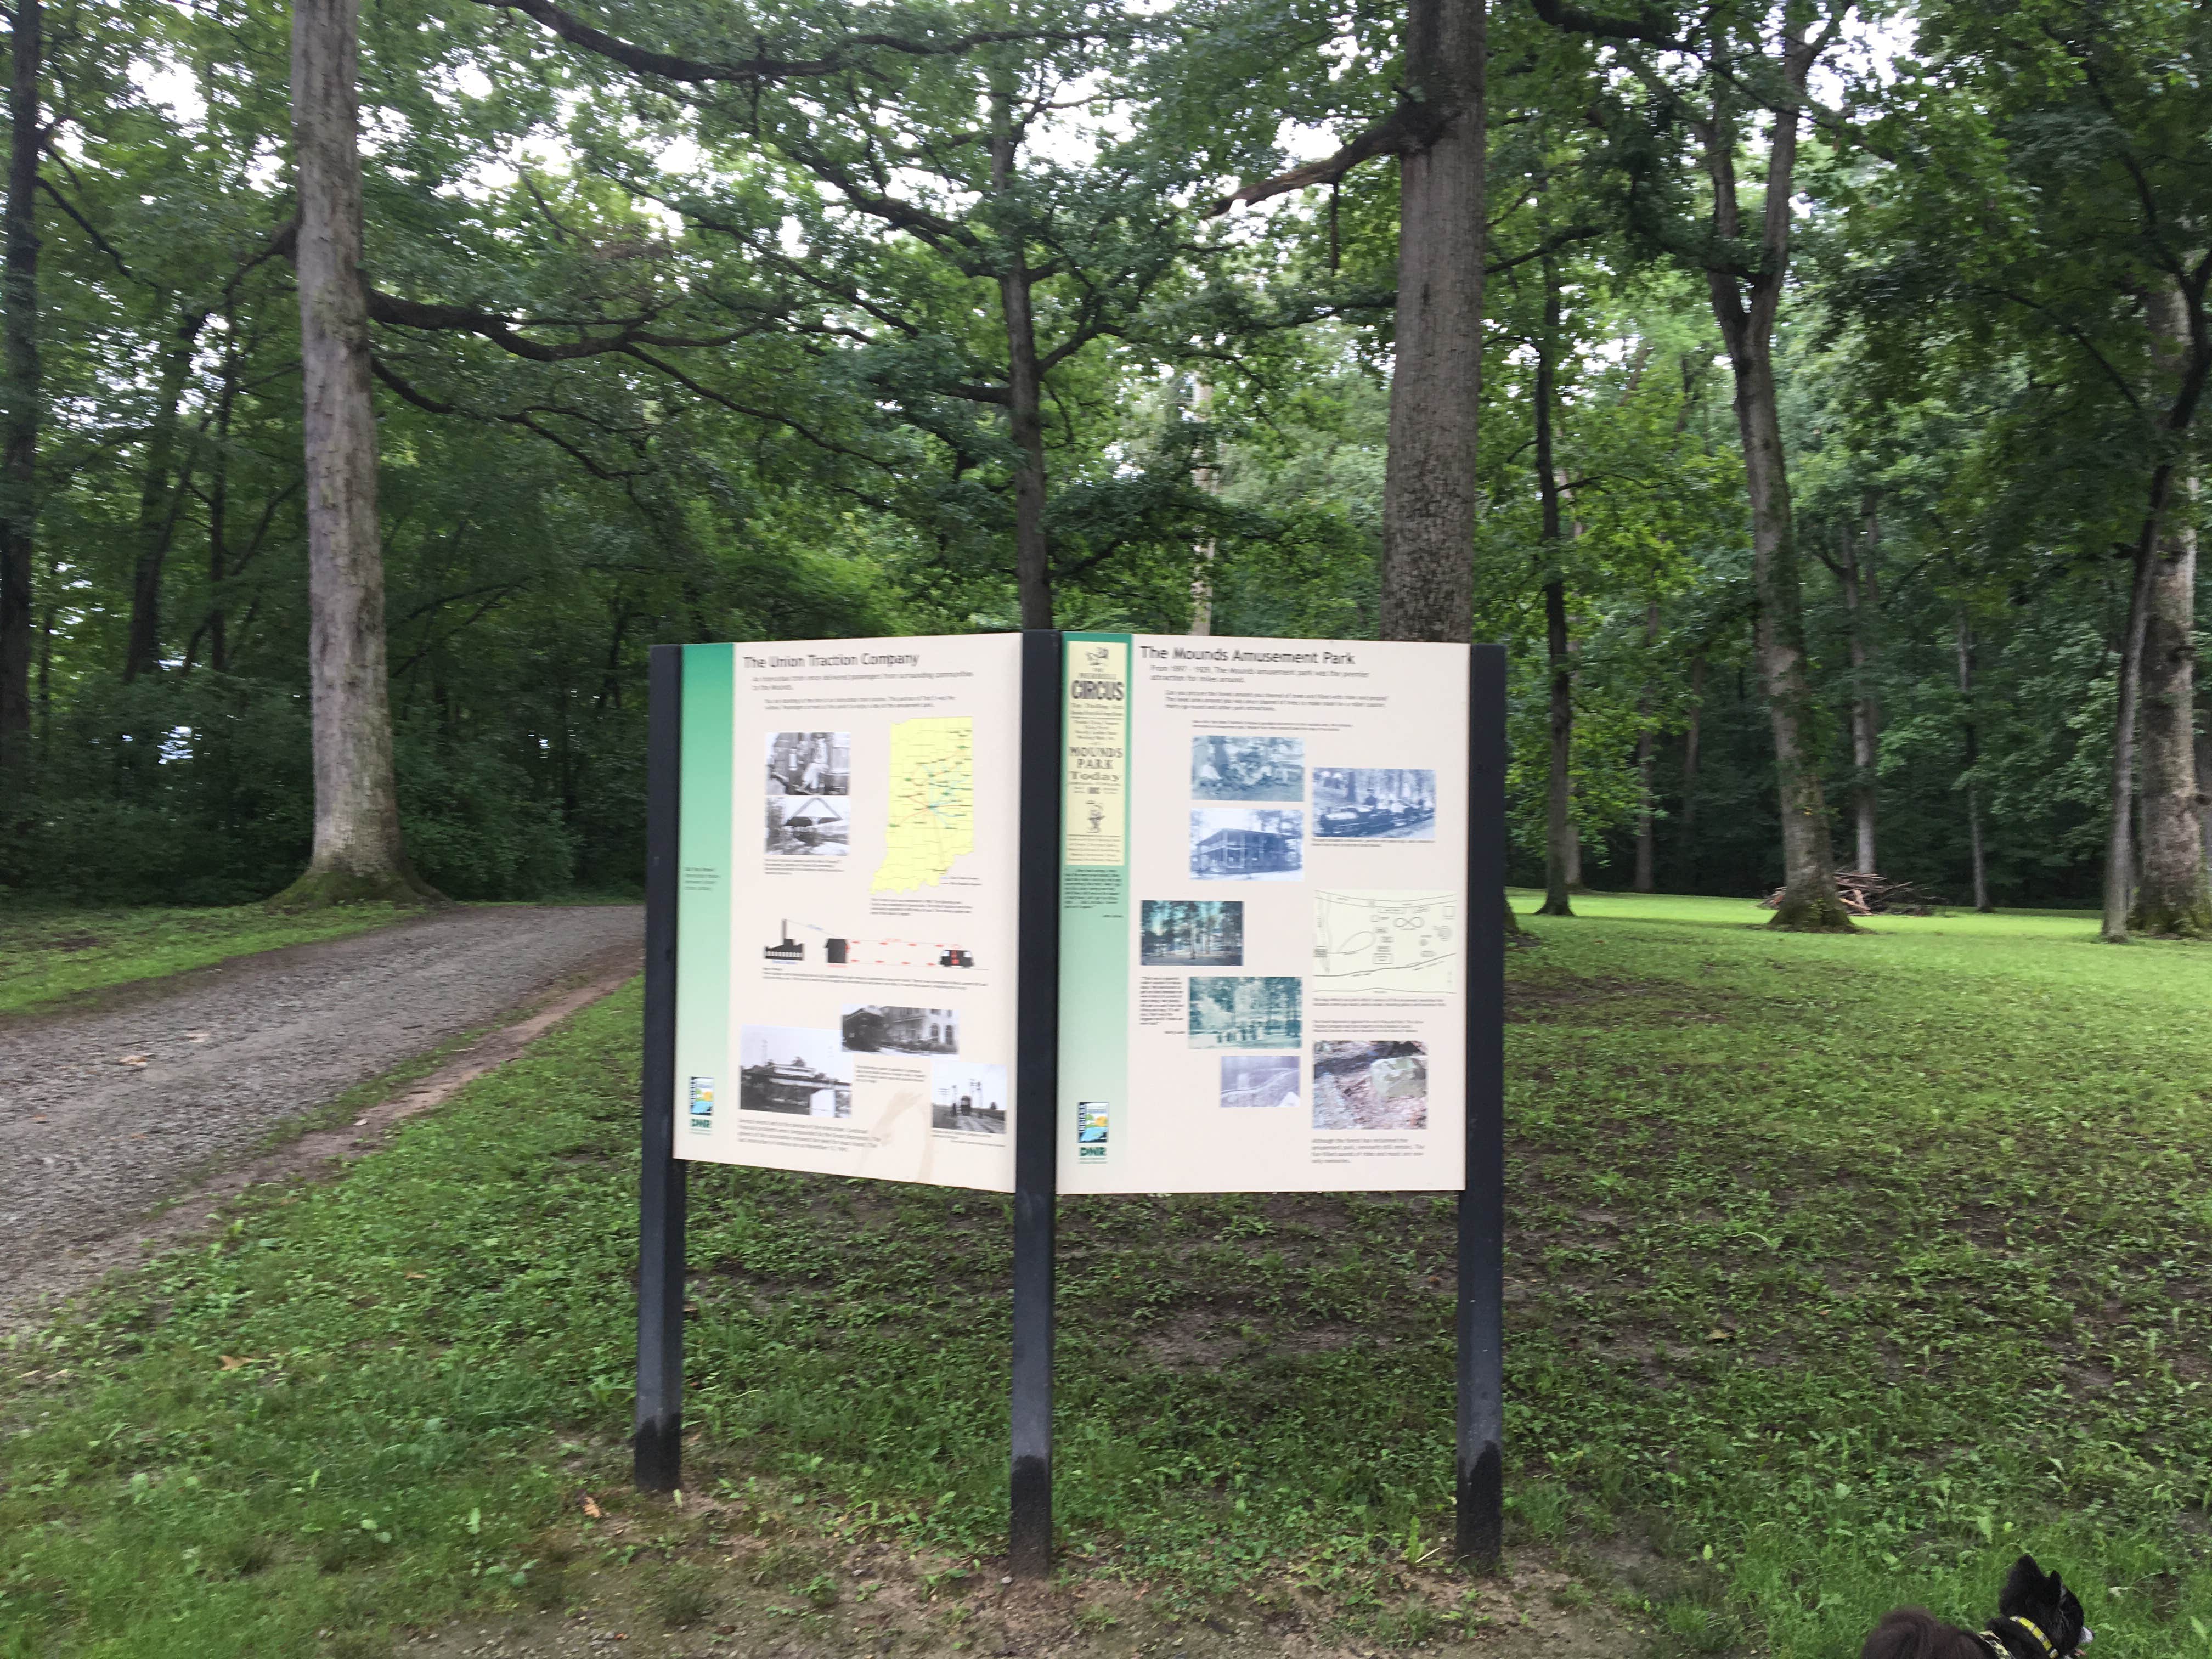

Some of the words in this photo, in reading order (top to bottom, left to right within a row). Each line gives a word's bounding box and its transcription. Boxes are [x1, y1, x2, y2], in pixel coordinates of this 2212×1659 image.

[742, 656, 766, 668] The
[768, 654, 805, 668] Union
[806, 654, 859, 667] Traction
[860, 653, 920, 668] Company
[1139, 646, 1169, 658] The
[1172, 647, 1229, 661] Mounds
[1231, 649, 1319, 663] Amusement
[1322, 651, 1356, 664] Park
[1071, 680, 1124, 701] CIRCUS
[1069, 747, 1124, 758] MOUNDS
[1076, 759, 1114, 769] PARK
[1068, 771, 1120, 782] Today
[1079, 1147, 1107, 1156] DNR
